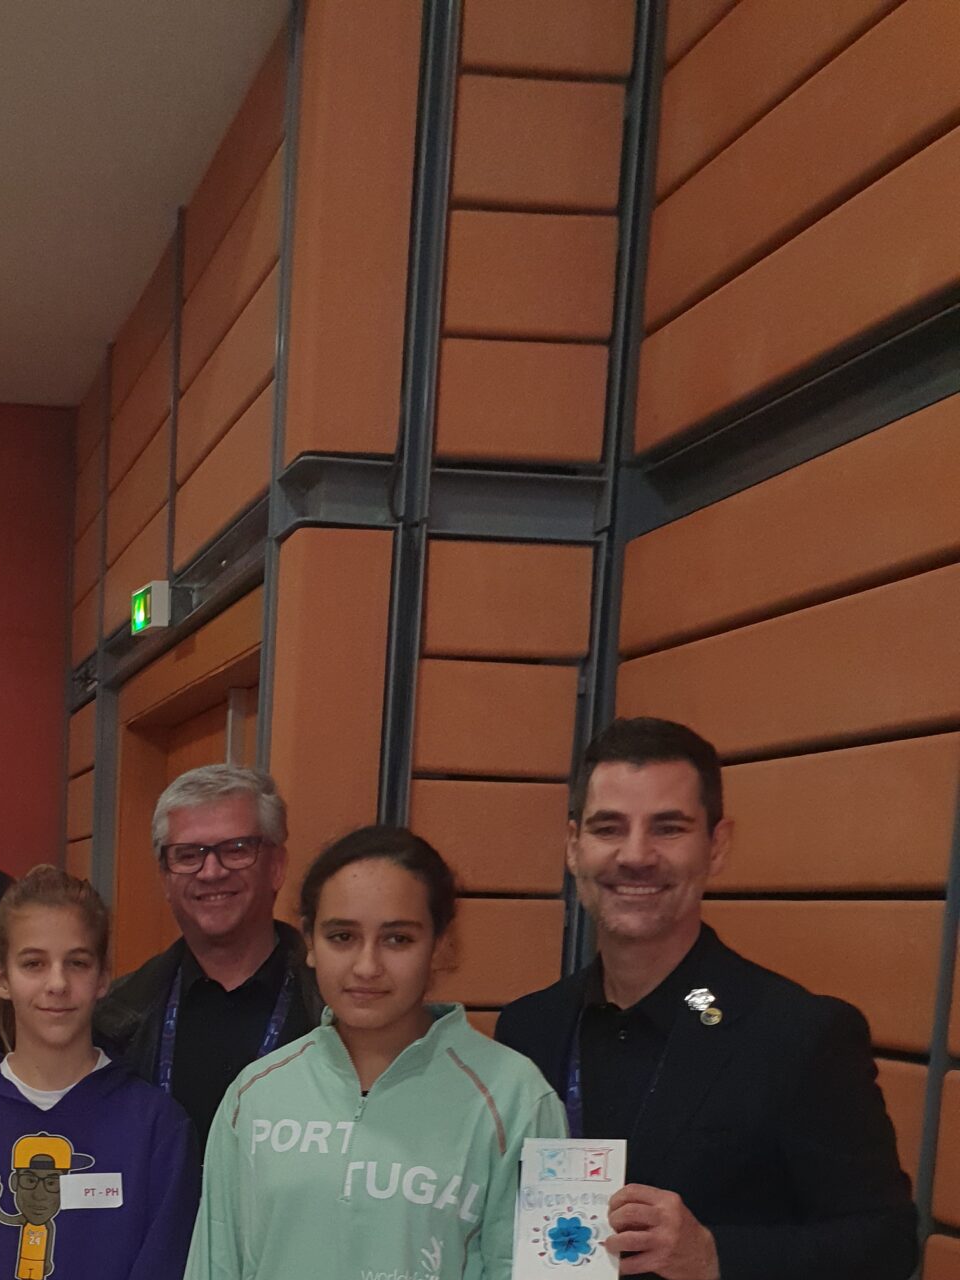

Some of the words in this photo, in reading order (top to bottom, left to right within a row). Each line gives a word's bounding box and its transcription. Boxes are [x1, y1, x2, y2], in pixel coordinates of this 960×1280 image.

[251, 1118, 355, 1154] PORT
[84, 1188, 96, 1197] PT
[105, 1187, 119, 1196] PH
[29, 1236, 41, 1246] 24
